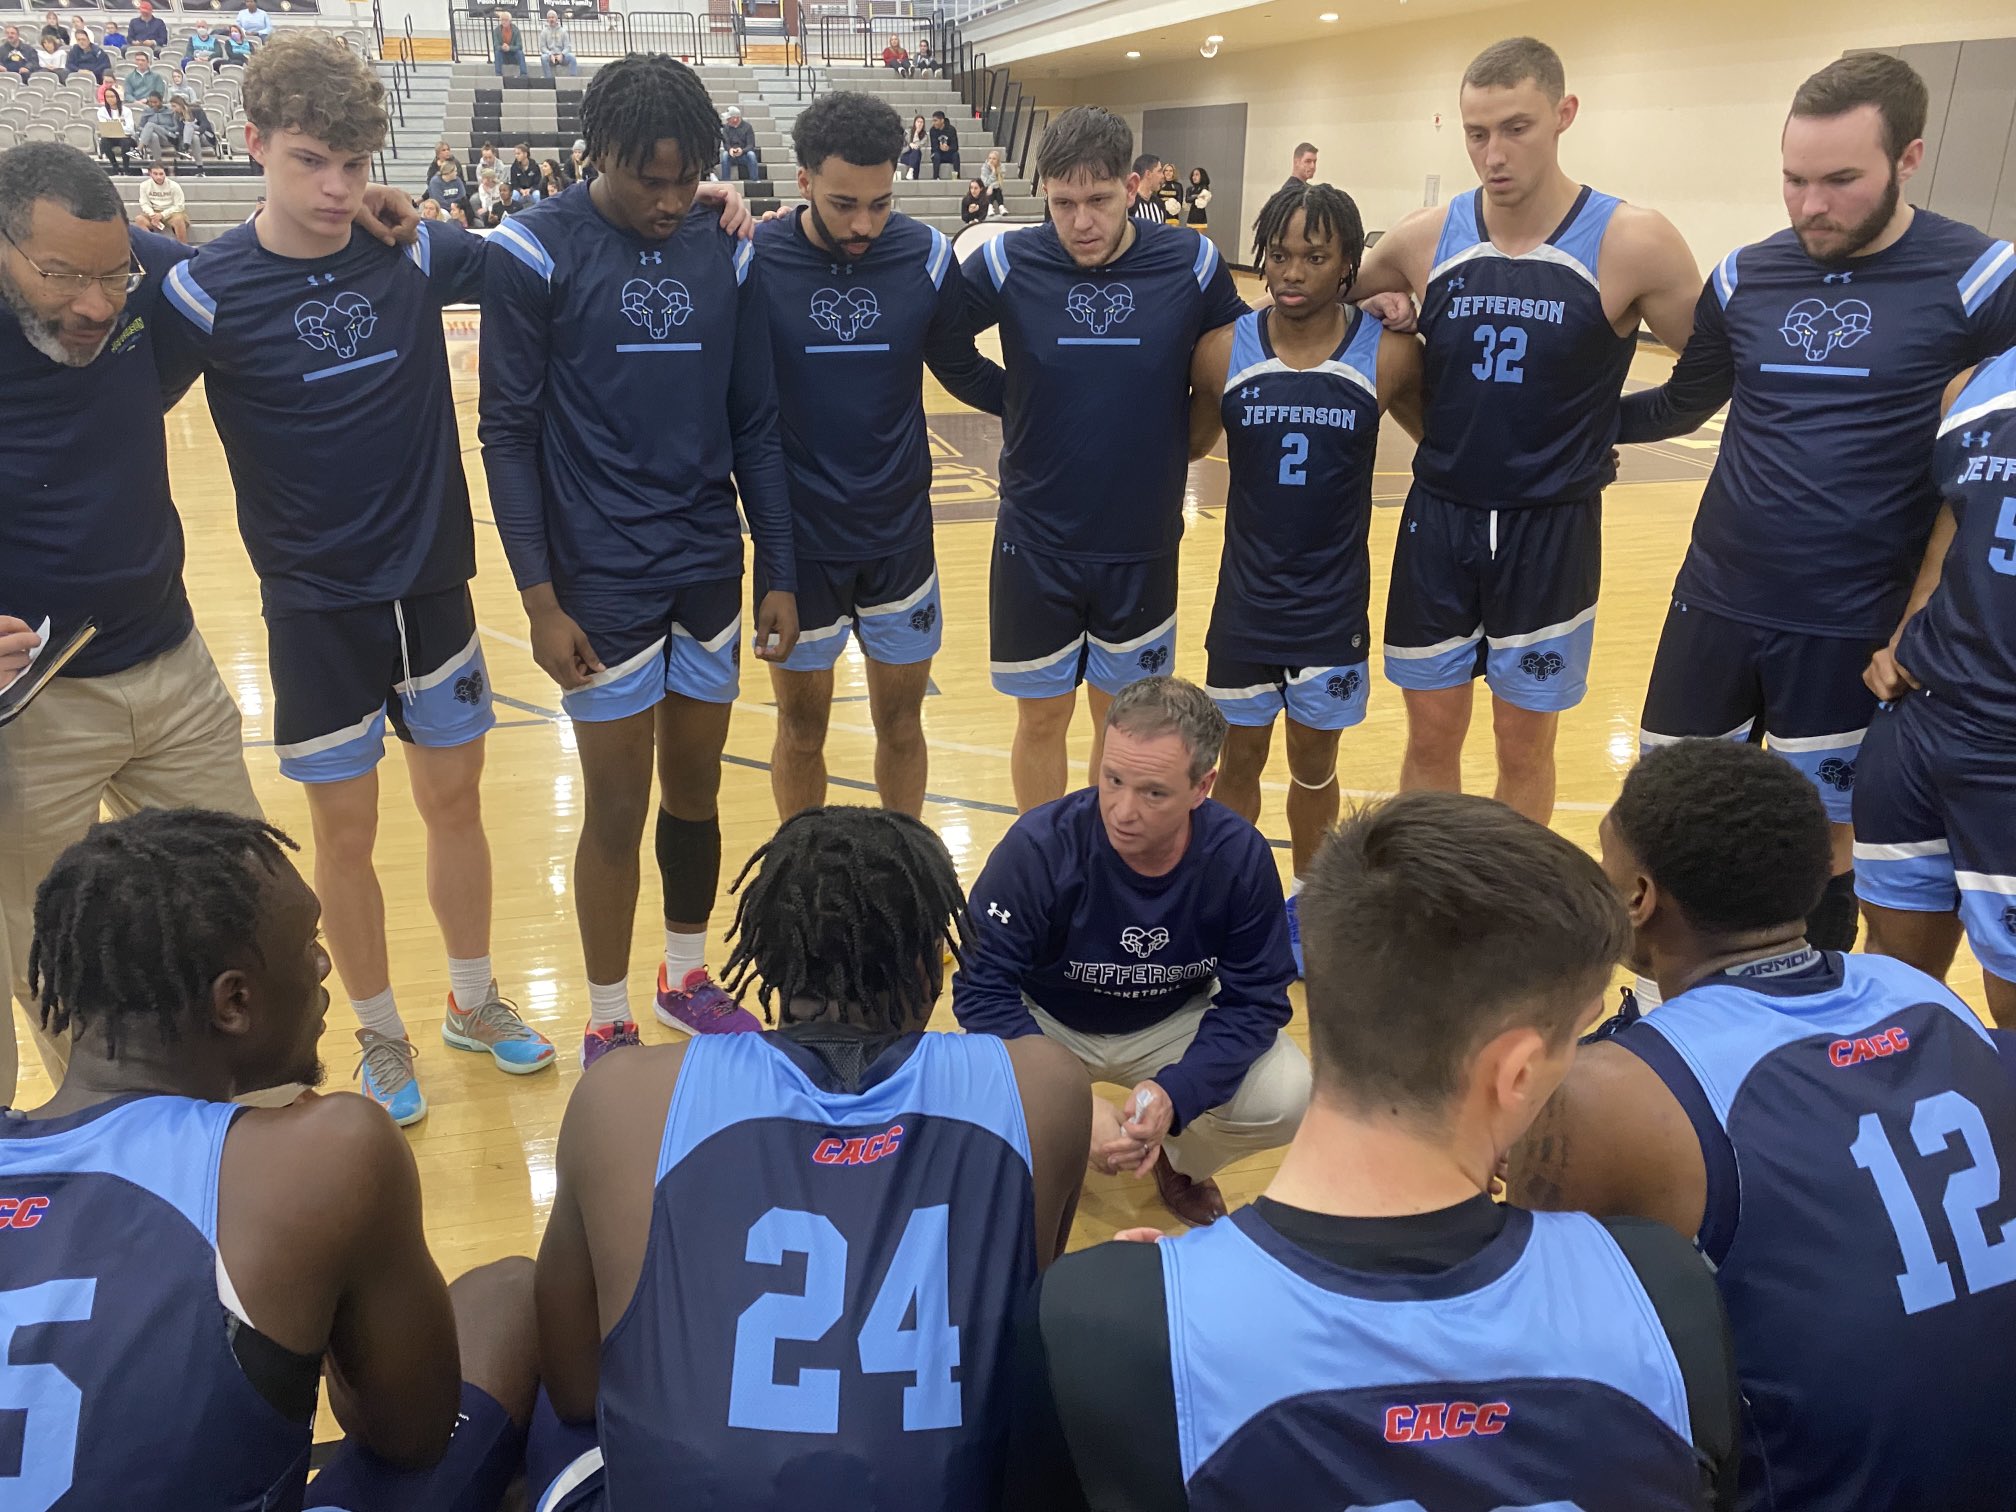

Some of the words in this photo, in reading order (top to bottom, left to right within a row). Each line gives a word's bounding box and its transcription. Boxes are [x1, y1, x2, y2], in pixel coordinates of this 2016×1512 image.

[1448, 295, 1565, 325] JEFFERSON
[1471, 324, 1528, 384] 32
[1241, 405, 1356, 431] JEFFERSON
[1278, 432, 1309, 486] 2
[1064, 957, 1218, 985] JEFFERSON
[1828, 1027, 1910, 1068] CACC
[811, 1125, 904, 1165] CACC
[1849, 1090, 2016, 1315] 12
[728, 1203, 963, 1434] 24
[1383, 1401, 1510, 1443] CACC
